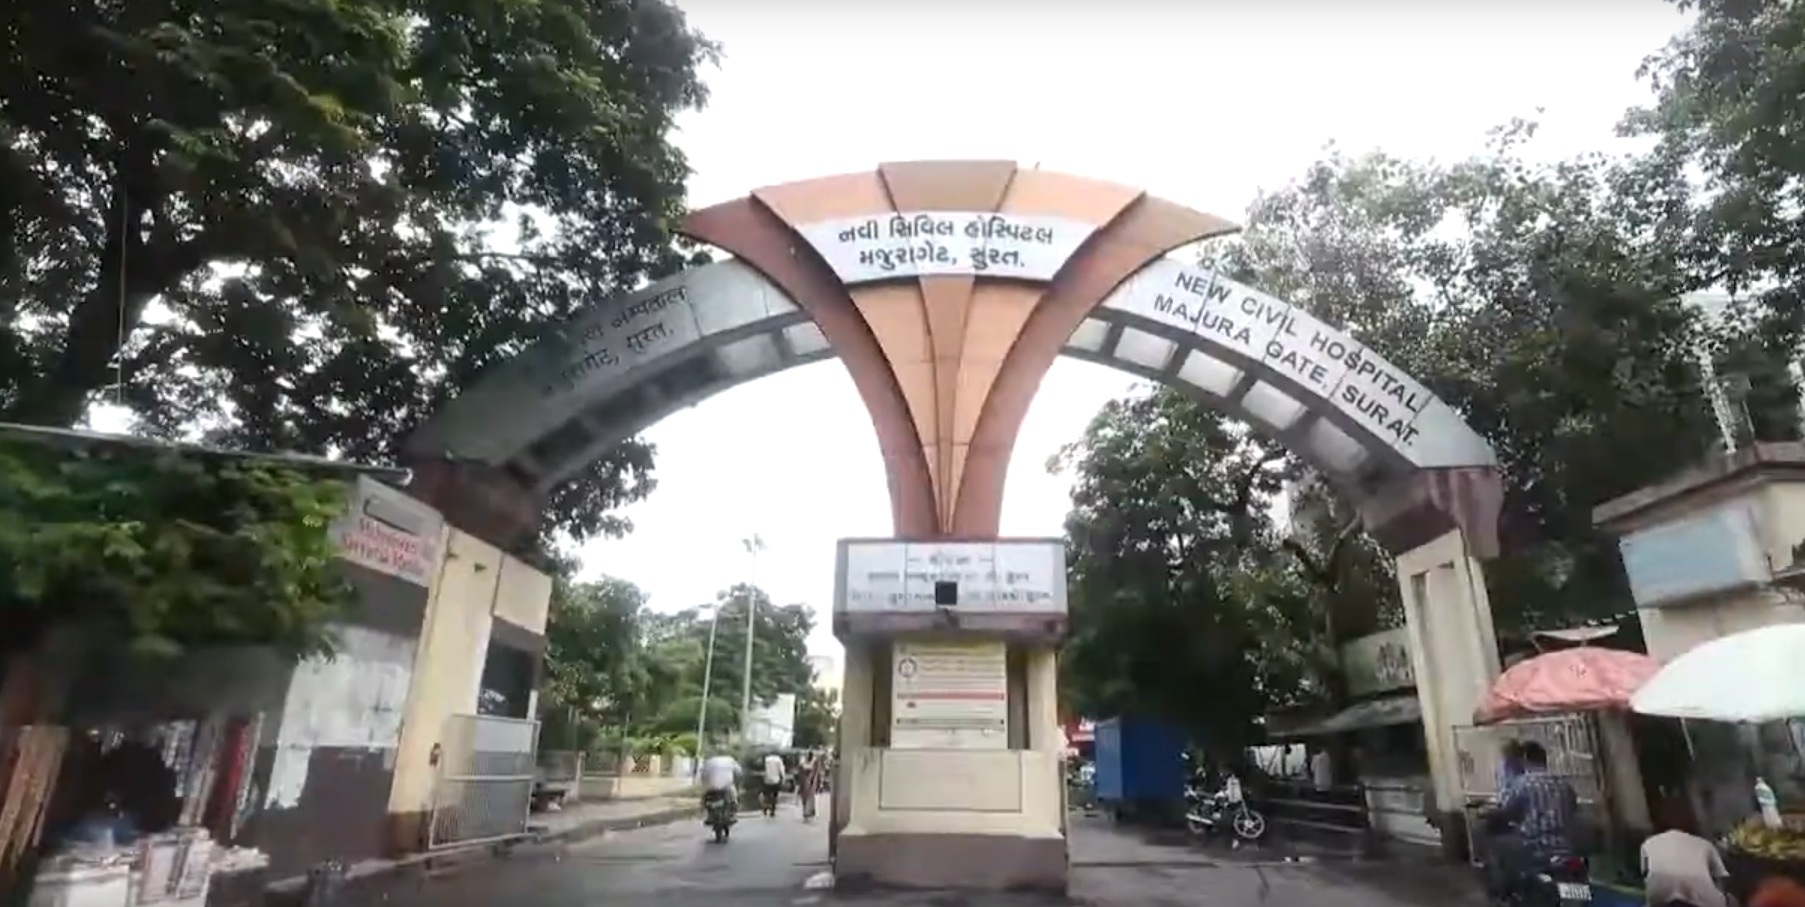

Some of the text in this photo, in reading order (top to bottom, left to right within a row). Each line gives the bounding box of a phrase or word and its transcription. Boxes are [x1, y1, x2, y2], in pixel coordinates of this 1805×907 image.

[837, 214, 1054, 244] નવી સિવિલ હોસ્પિટલ
[1153, 293, 1251, 346] MAJURA
[1341, 384, 1420, 446] SURAT.
[1174, 270, 1420, 413] NEW CIVIL HOSPITAL
